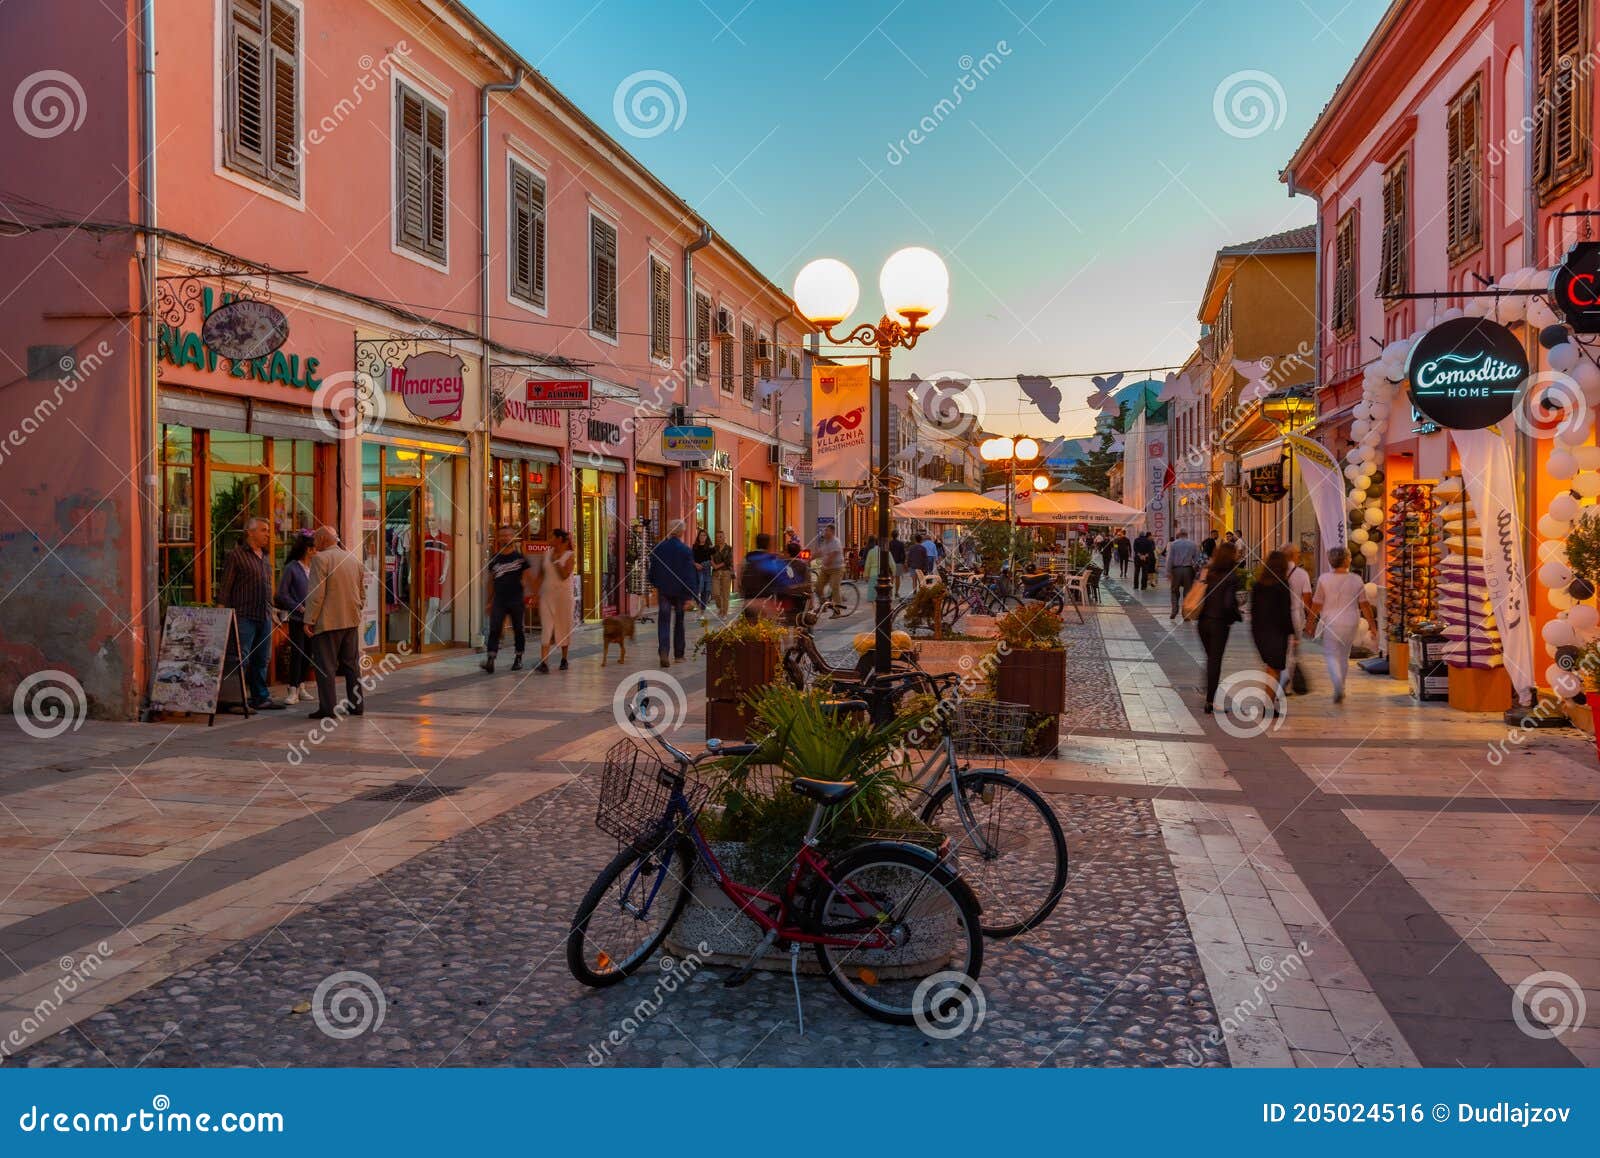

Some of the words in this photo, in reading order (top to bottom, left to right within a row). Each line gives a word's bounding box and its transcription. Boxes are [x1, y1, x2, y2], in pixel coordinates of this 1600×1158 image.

[1568, 273, 1600, 306] C
[1417, 356, 1521, 388] Comodita
[1448, 387, 1490, 397] HOME
[817, 429, 864, 447] VLLAZNIA
